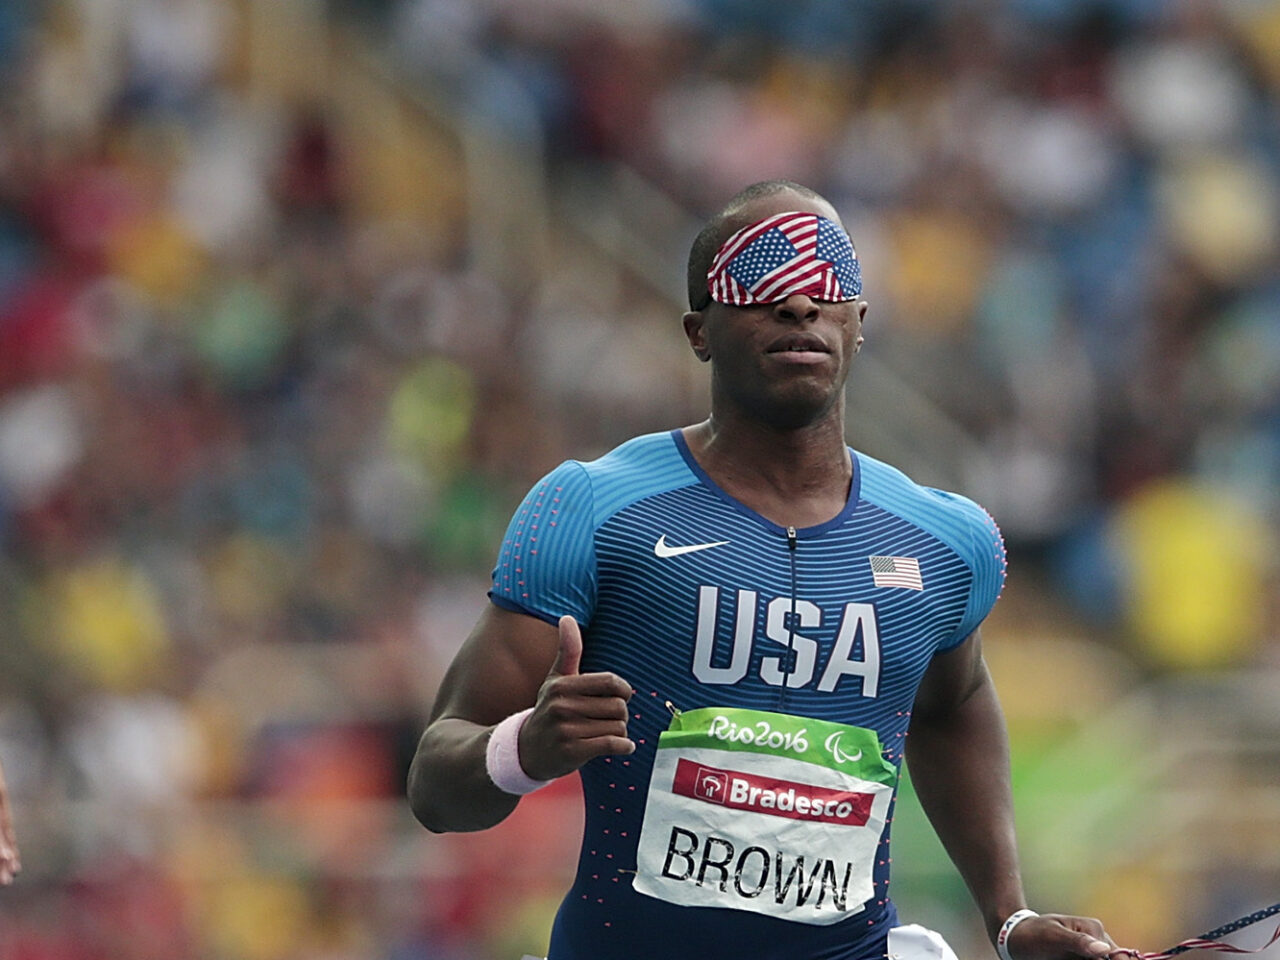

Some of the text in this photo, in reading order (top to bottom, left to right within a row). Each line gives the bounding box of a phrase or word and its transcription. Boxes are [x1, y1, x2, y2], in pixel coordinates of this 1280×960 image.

[692, 585, 881, 698] USA
[707, 715, 809, 754] Rio2016
[729, 774, 853, 820] Bradesco
[661, 826, 853, 911] BROWN
